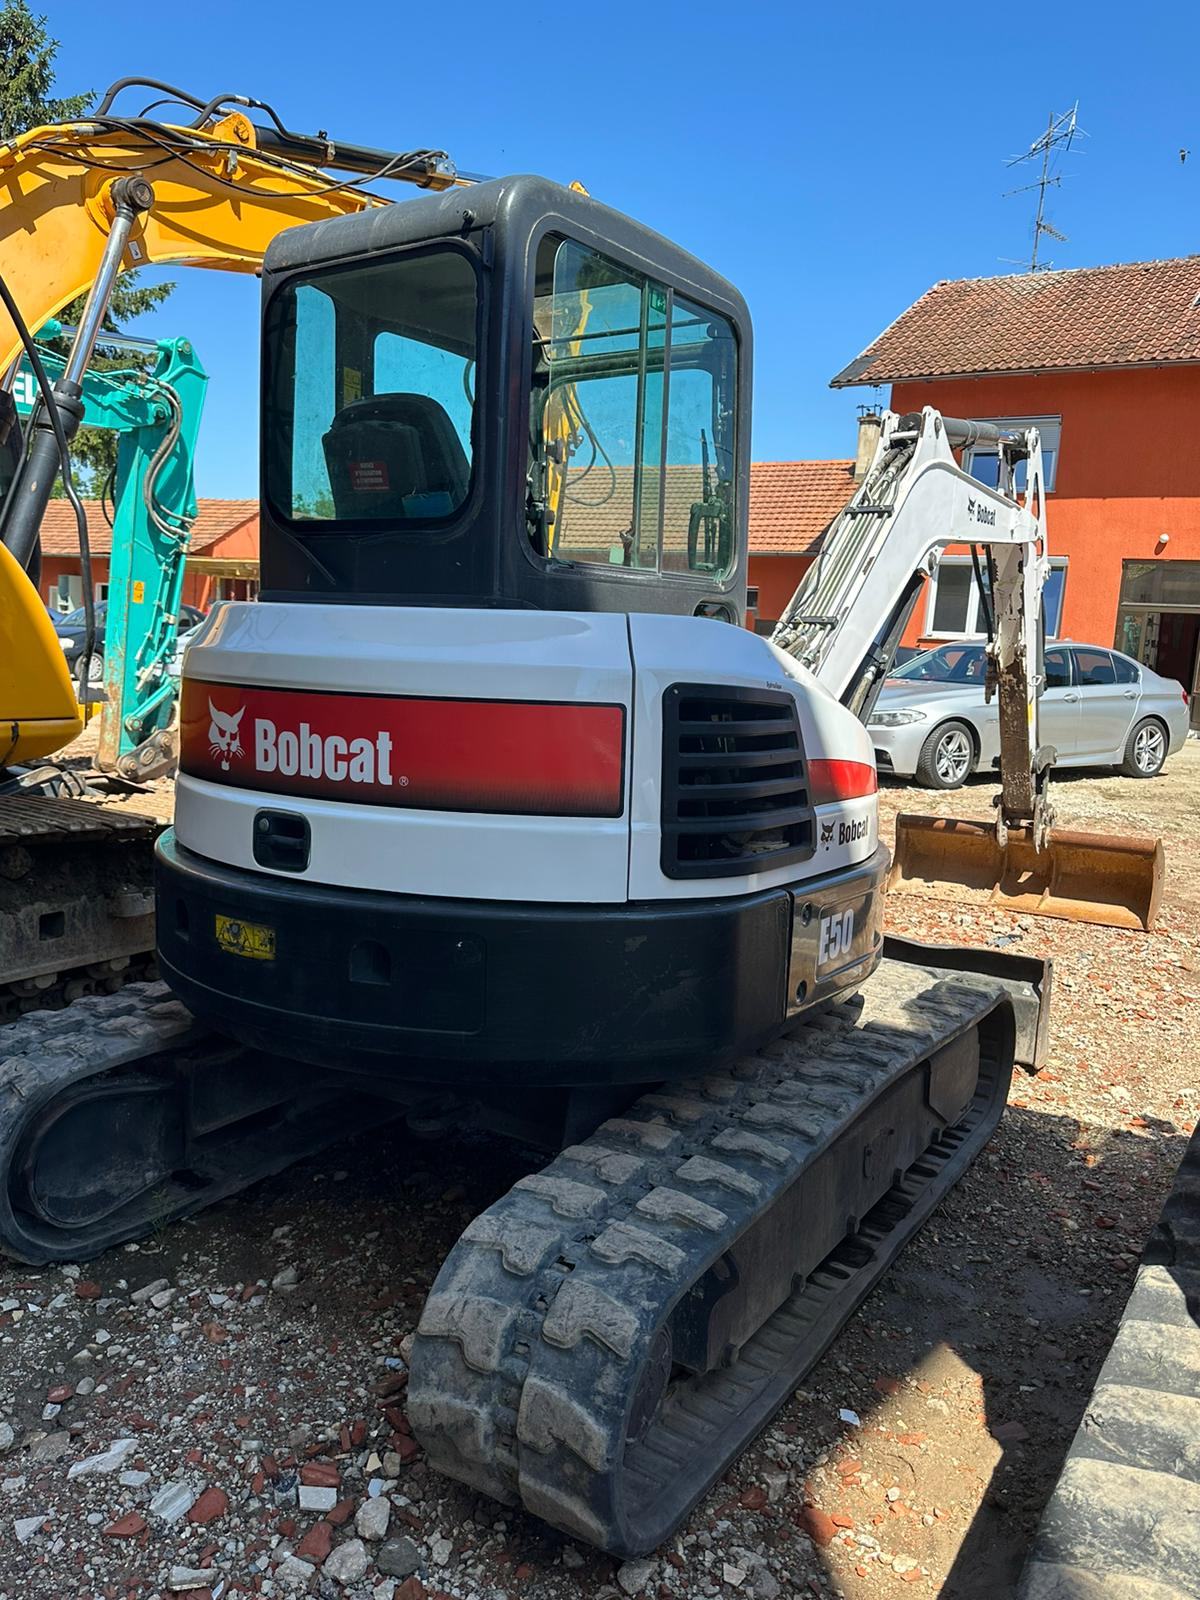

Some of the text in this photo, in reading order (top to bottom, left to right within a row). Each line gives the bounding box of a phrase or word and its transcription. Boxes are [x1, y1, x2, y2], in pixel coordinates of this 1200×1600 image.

[255, 718, 393, 785] Bobcat
[838, 815, 869, 846] Bobcat
[818, 908, 854, 966] E50
